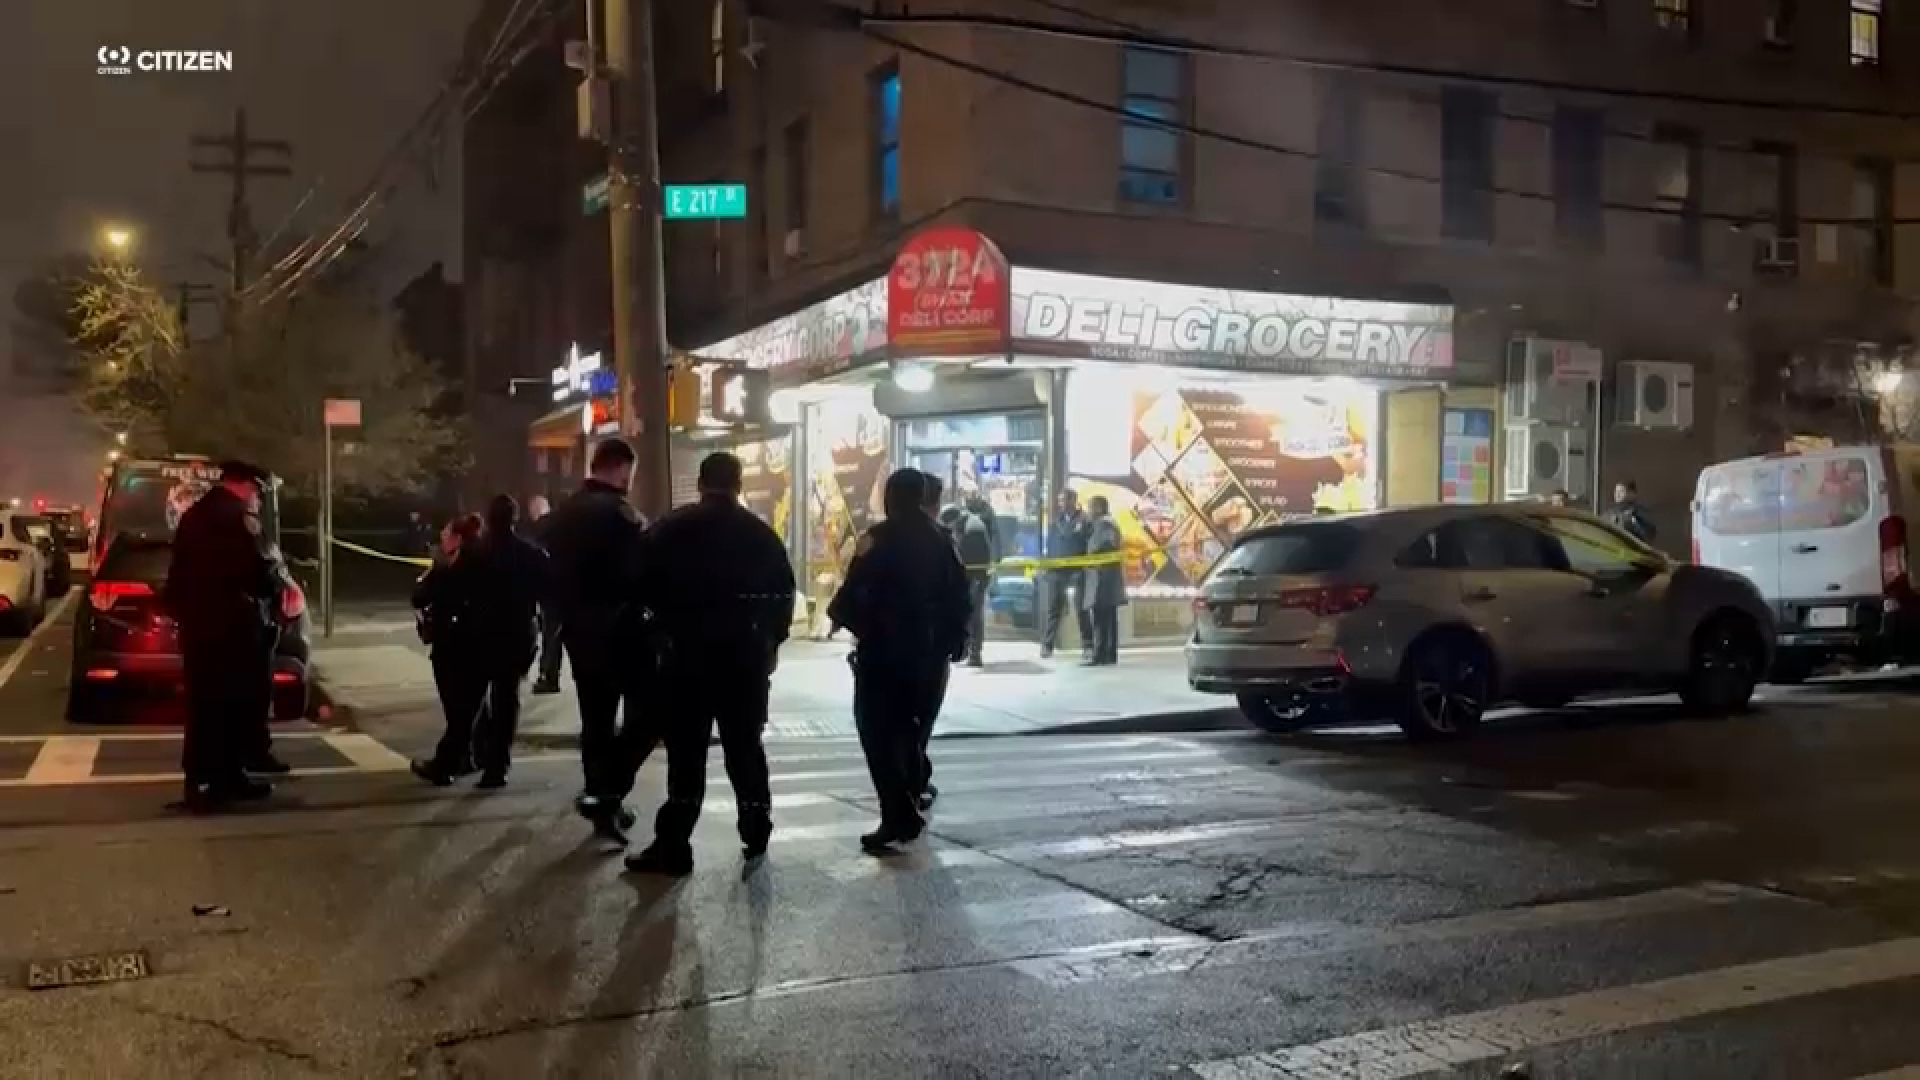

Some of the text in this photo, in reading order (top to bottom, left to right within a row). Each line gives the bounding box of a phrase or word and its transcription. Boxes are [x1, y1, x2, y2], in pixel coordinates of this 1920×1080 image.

[671, 189, 682, 213] E
[688, 187, 719, 214] 217
[942, 308, 995, 326] CORP
[1024, 291, 1159, 347] DELI
[1172, 305, 1428, 366] GROCERY
